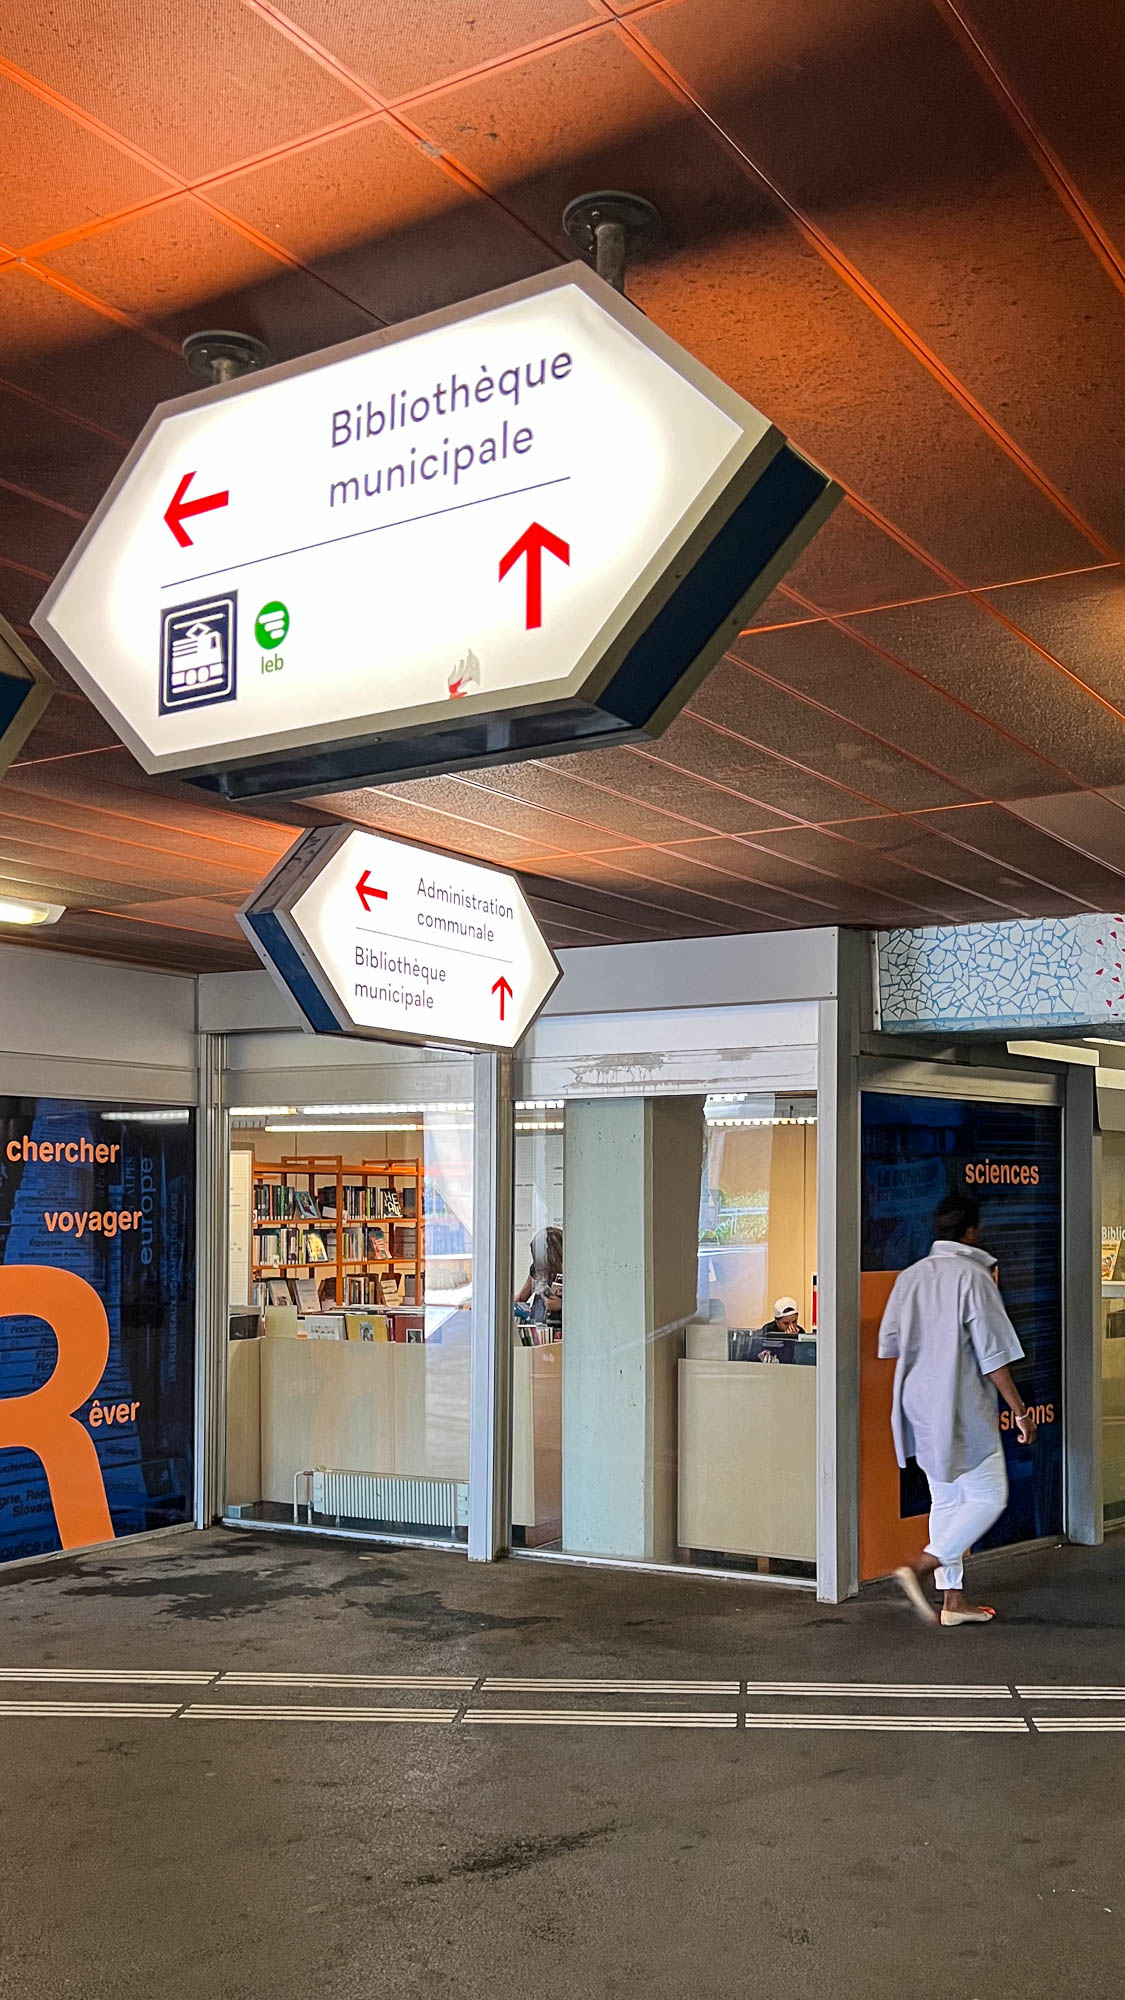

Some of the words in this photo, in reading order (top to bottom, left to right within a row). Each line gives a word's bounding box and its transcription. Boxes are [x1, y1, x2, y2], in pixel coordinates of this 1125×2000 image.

[331, 351, 573, 448] Bibliothèque
[329, 420, 534, 507] municipale
[261, 654, 284, 674] leb
[417, 877, 513, 919] Administration
[417, 912, 494, 942] communale
[355, 946, 446, 984] Bibliothèque
[354, 983, 434, 1010] municipale
[6, 1135, 120, 1163] chercher
[965, 1158, 1039, 1185] sciences
[44, 1210, 142, 1238] voyager
[140, 1157, 156, 1265] europe
